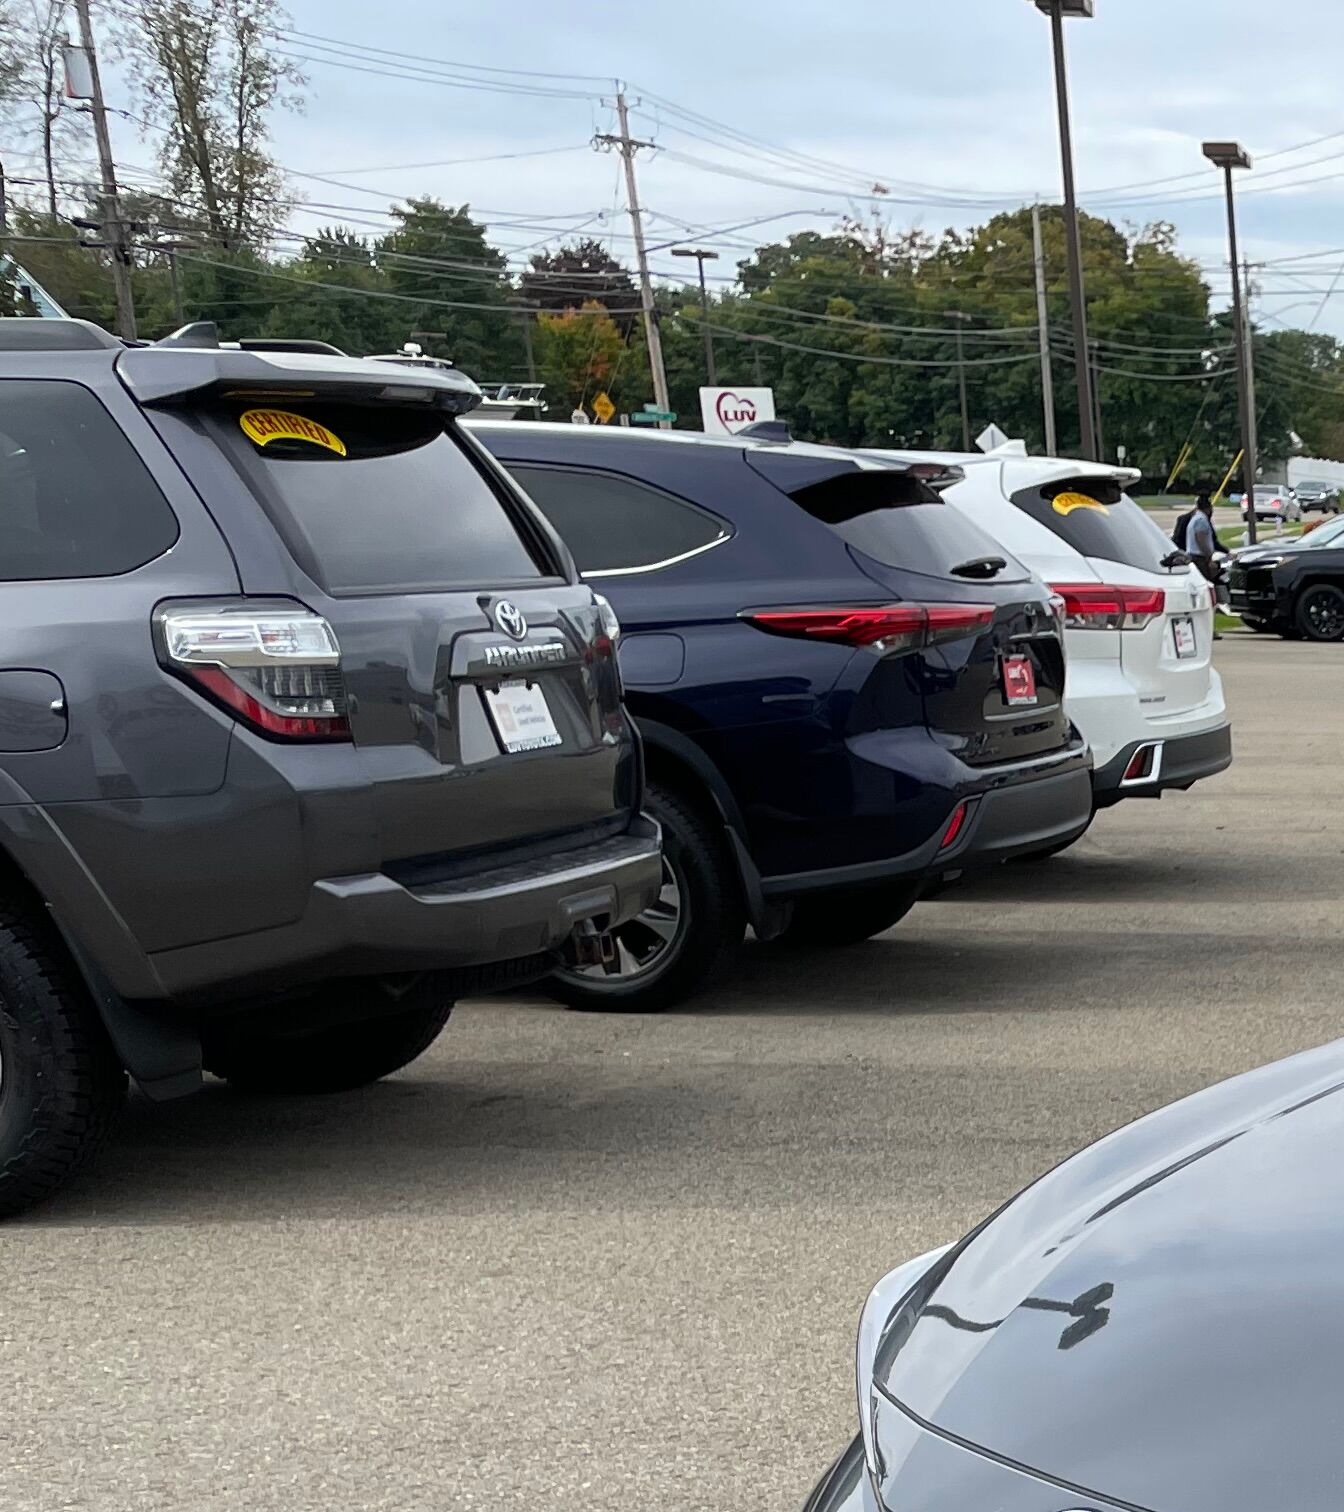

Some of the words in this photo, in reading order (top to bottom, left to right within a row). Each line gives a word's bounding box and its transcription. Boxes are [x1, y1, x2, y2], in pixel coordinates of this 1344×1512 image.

[723, 409, 757, 422] LUV
[244, 411, 332, 446] CERTIFIED
[484, 642, 566, 667] 4RUNNER
